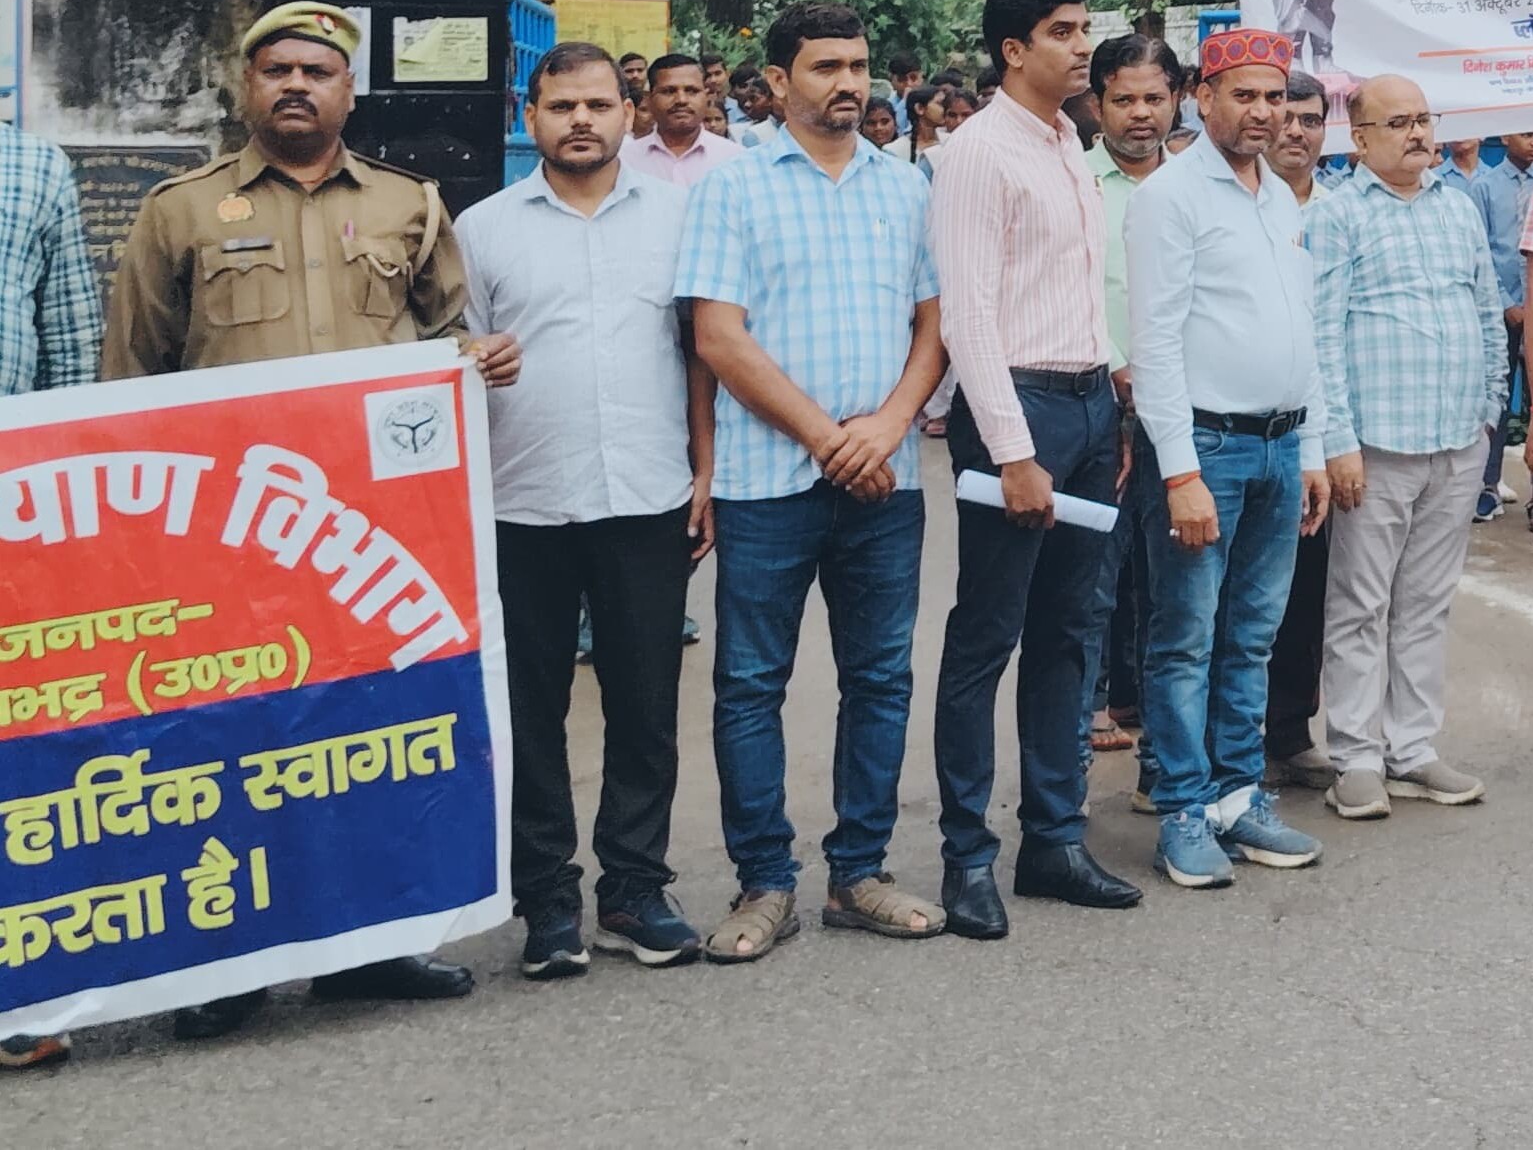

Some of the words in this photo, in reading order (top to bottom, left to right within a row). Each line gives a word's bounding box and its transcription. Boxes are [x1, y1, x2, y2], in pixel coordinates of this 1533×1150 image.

[0, 598, 215, 663] जनपद-
[220, 443, 469, 673] विभाग
[0, 748, 226, 866] हार्दिक
[239, 712, 459, 812] स्वागत
